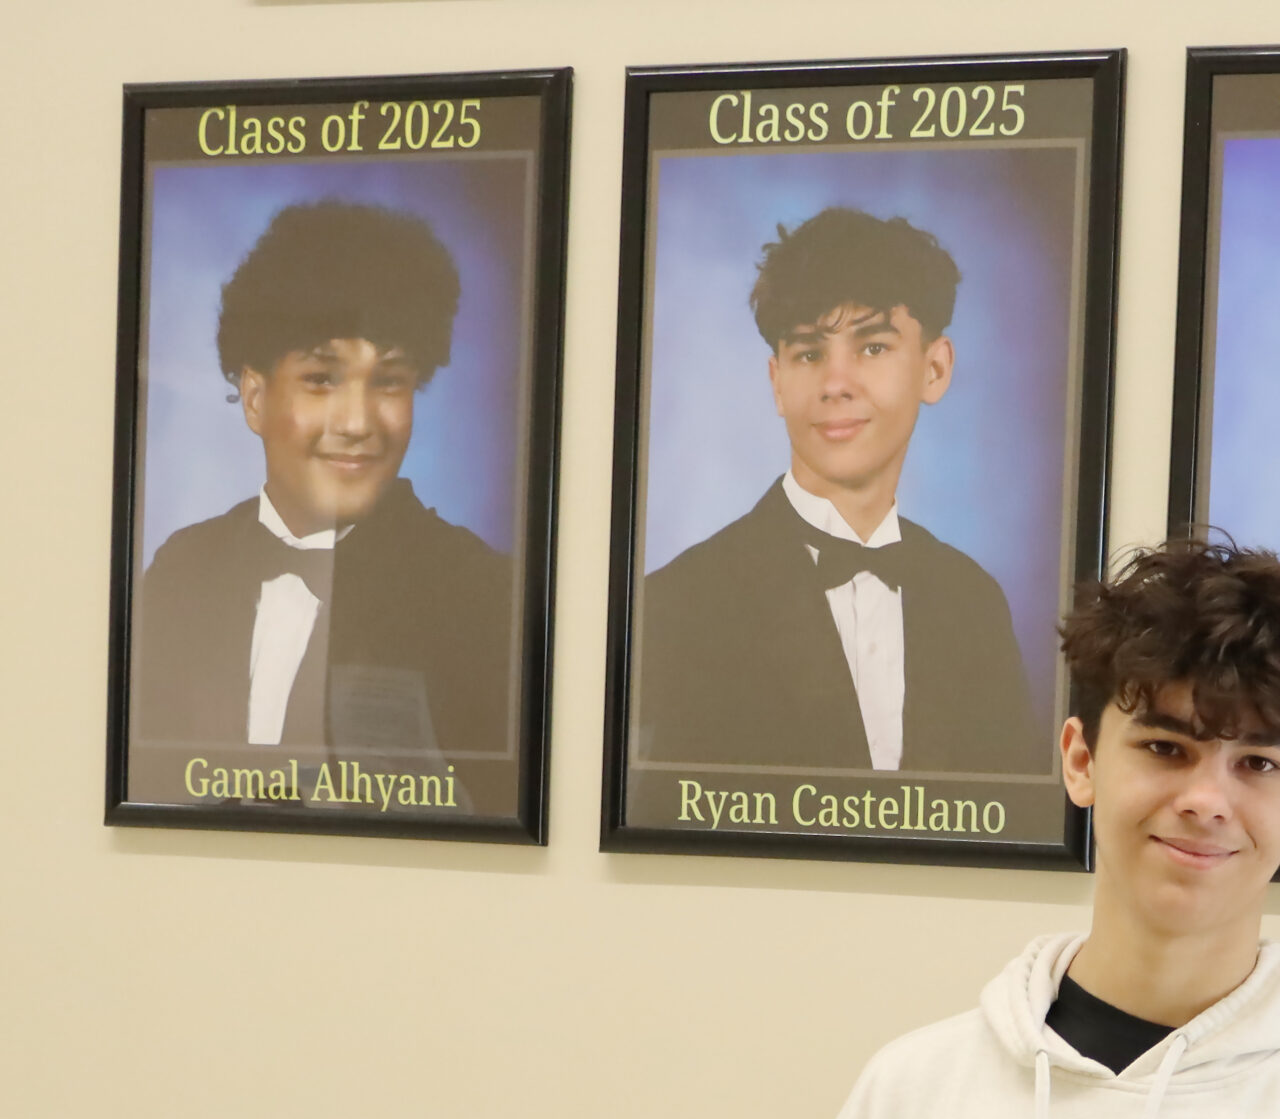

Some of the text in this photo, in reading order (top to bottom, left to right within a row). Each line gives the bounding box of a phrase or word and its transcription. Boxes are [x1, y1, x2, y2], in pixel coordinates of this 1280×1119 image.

[198, 98, 482, 156] Class of 2025
[708, 84, 1025, 143] Class of 2025
[184, 757, 458, 813] Gamal Alhyani
[678, 778, 1006, 834] Ryan Castellano
